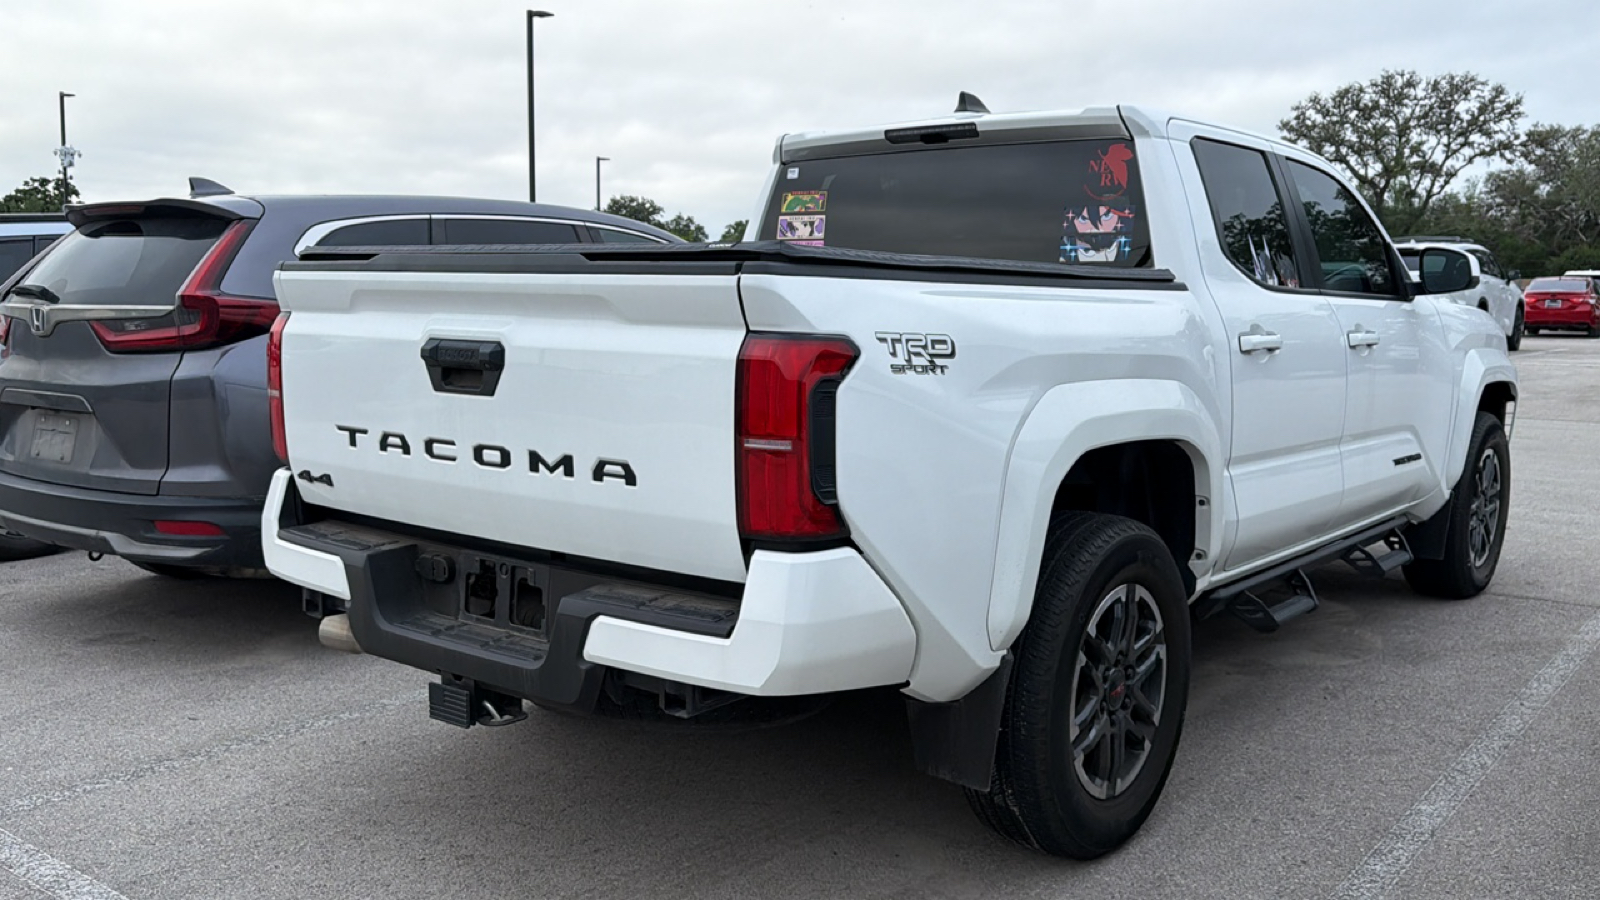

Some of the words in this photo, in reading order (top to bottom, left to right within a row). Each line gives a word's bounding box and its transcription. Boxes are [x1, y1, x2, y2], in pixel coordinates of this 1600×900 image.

[875, 331, 956, 362] TRD
[890, 363, 950, 376] SPORT
[335, 424, 637, 487] TACOMA
